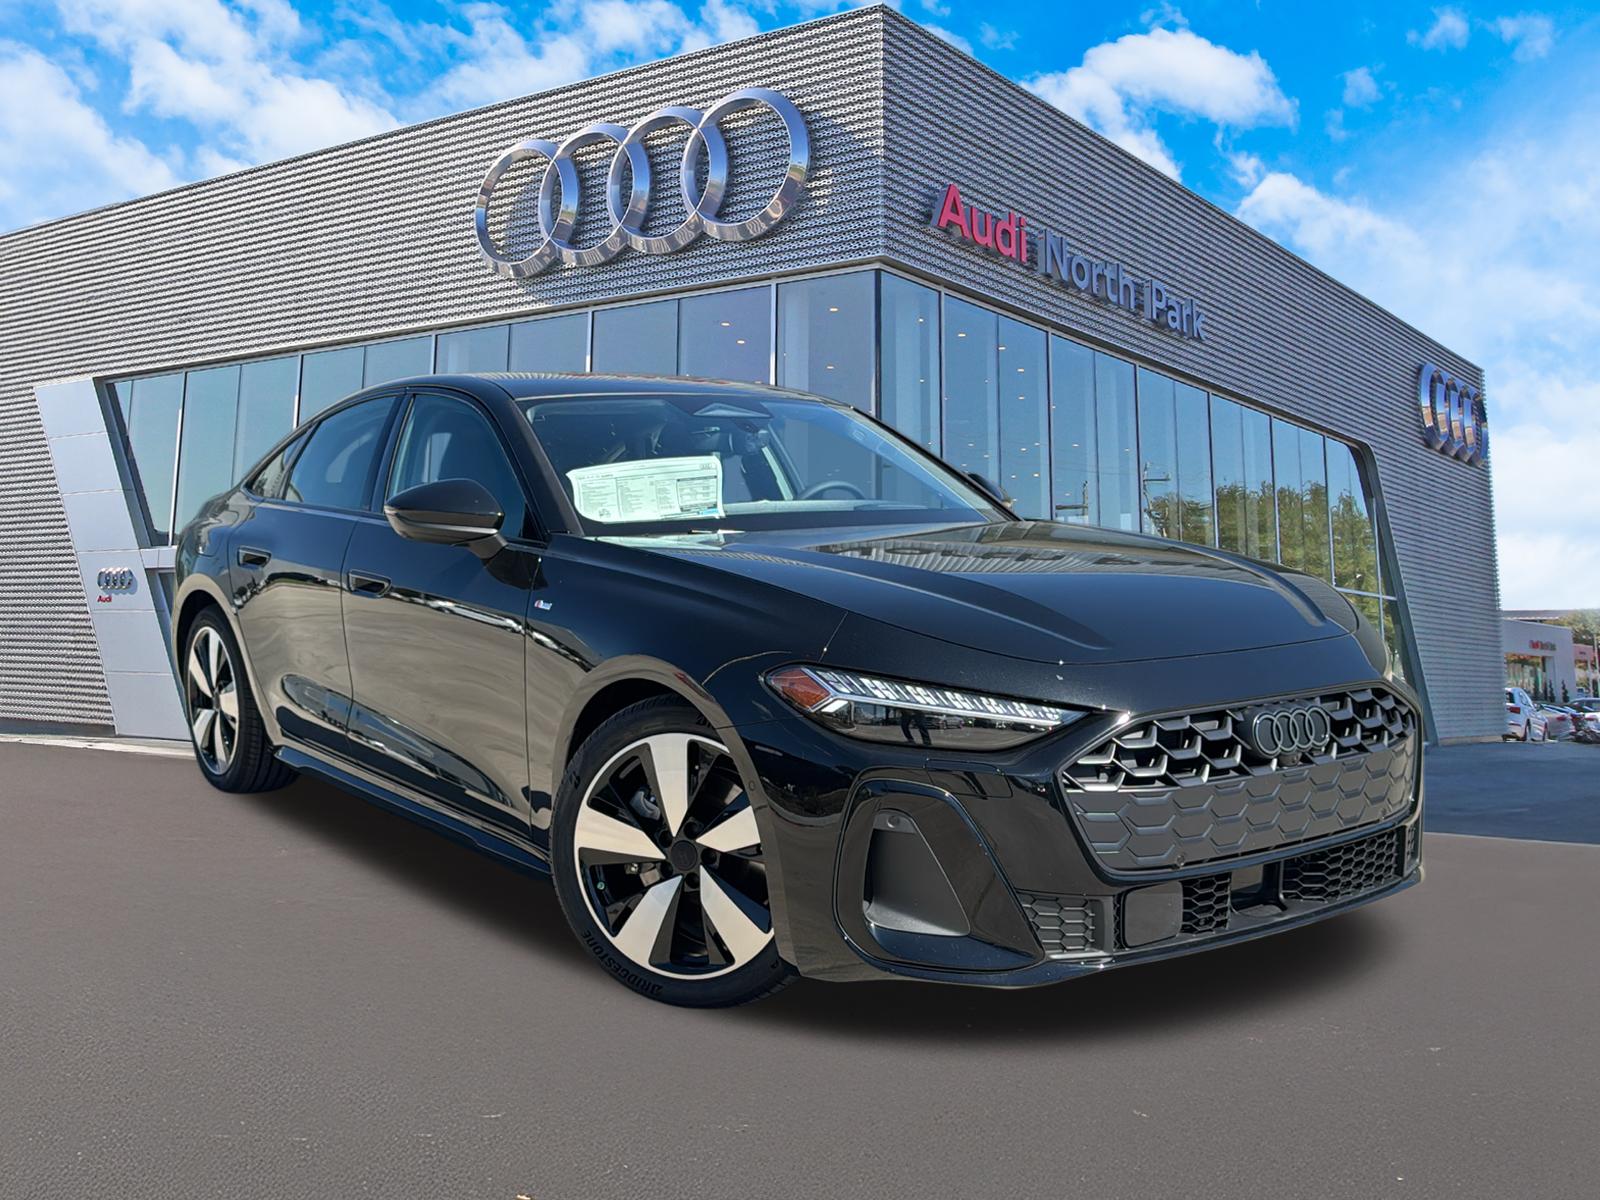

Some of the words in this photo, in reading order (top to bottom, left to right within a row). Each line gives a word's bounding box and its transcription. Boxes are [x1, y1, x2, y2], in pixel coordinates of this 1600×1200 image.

[932, 183, 1029, 264] Audi
[1039, 229, 1137, 310] North
[1144, 278, 1207, 341] Park
[97, 595, 112, 603] Audi
